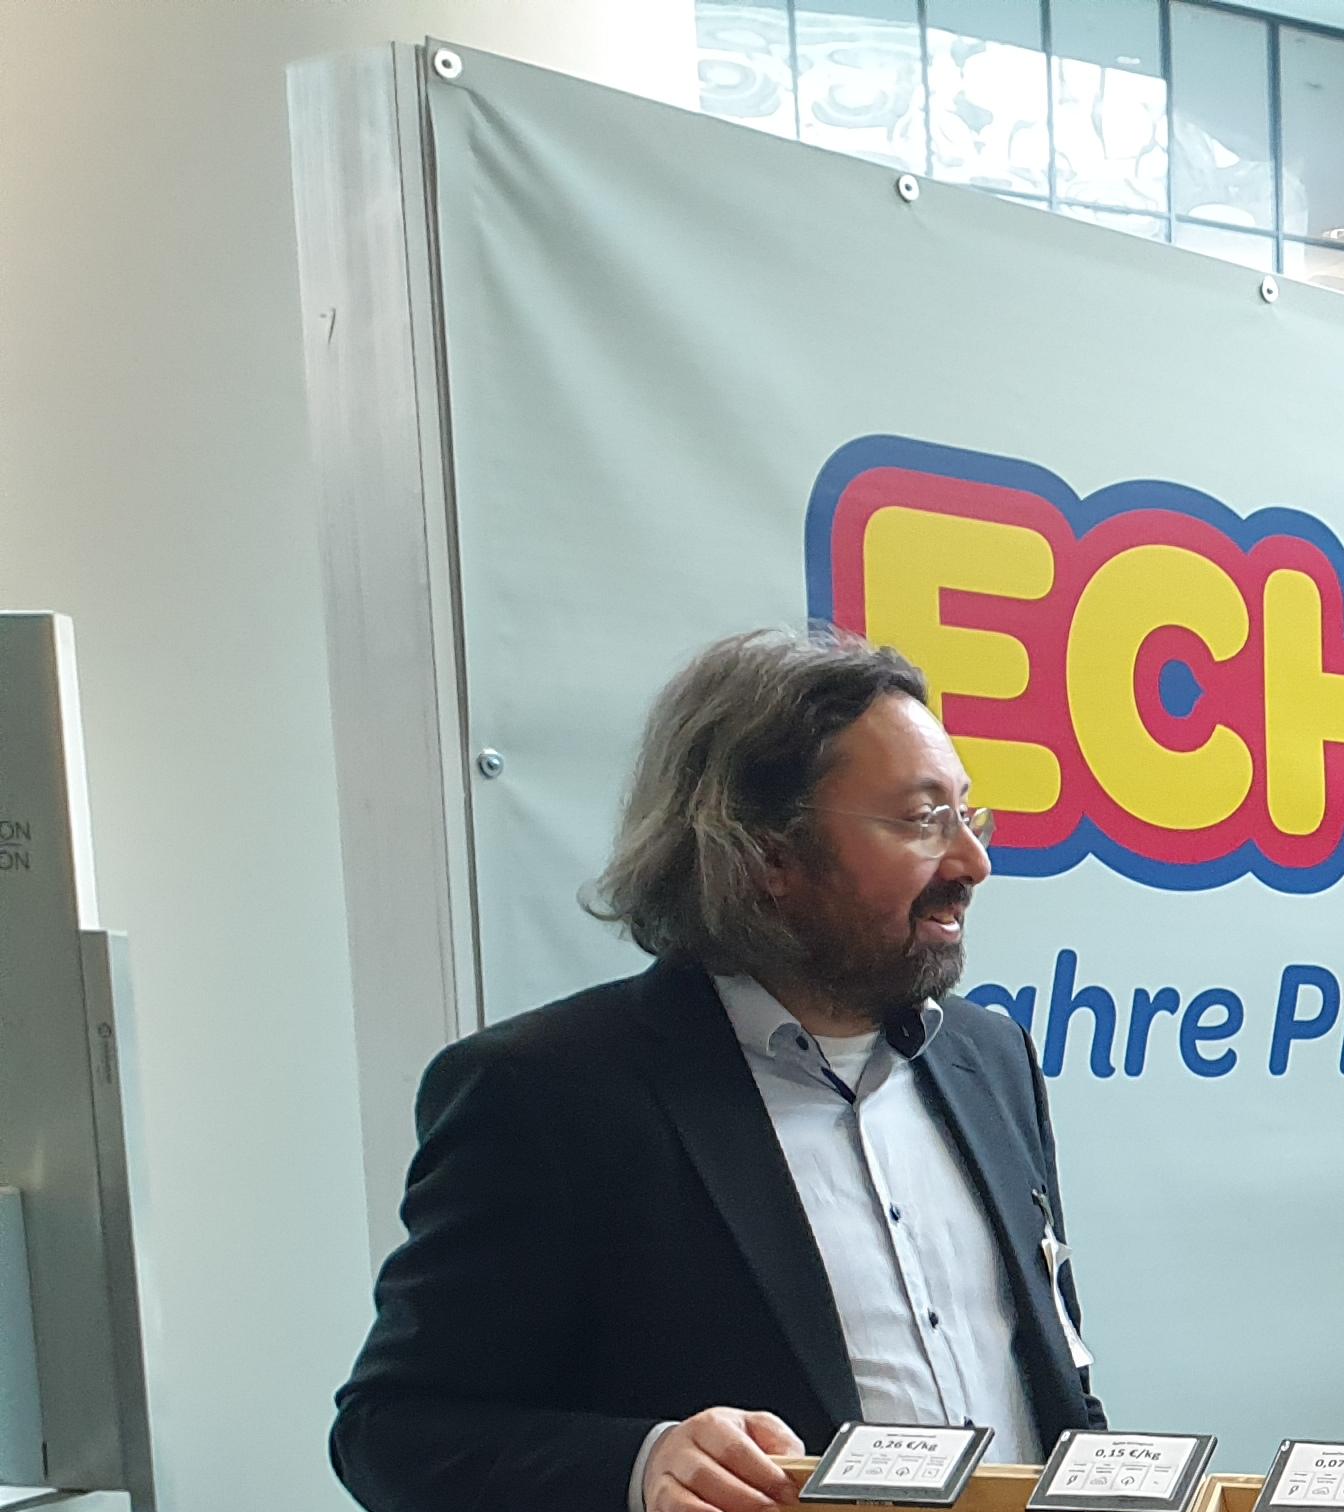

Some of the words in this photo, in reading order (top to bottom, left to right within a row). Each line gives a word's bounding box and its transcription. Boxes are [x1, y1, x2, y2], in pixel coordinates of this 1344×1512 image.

[872, 1439, 903, 1450] 0,26
[906, 1439, 938, 1452] €/kg
[1095, 1448, 1126, 1459] 0,15
[1129, 1448, 1162, 1461] €/kg
